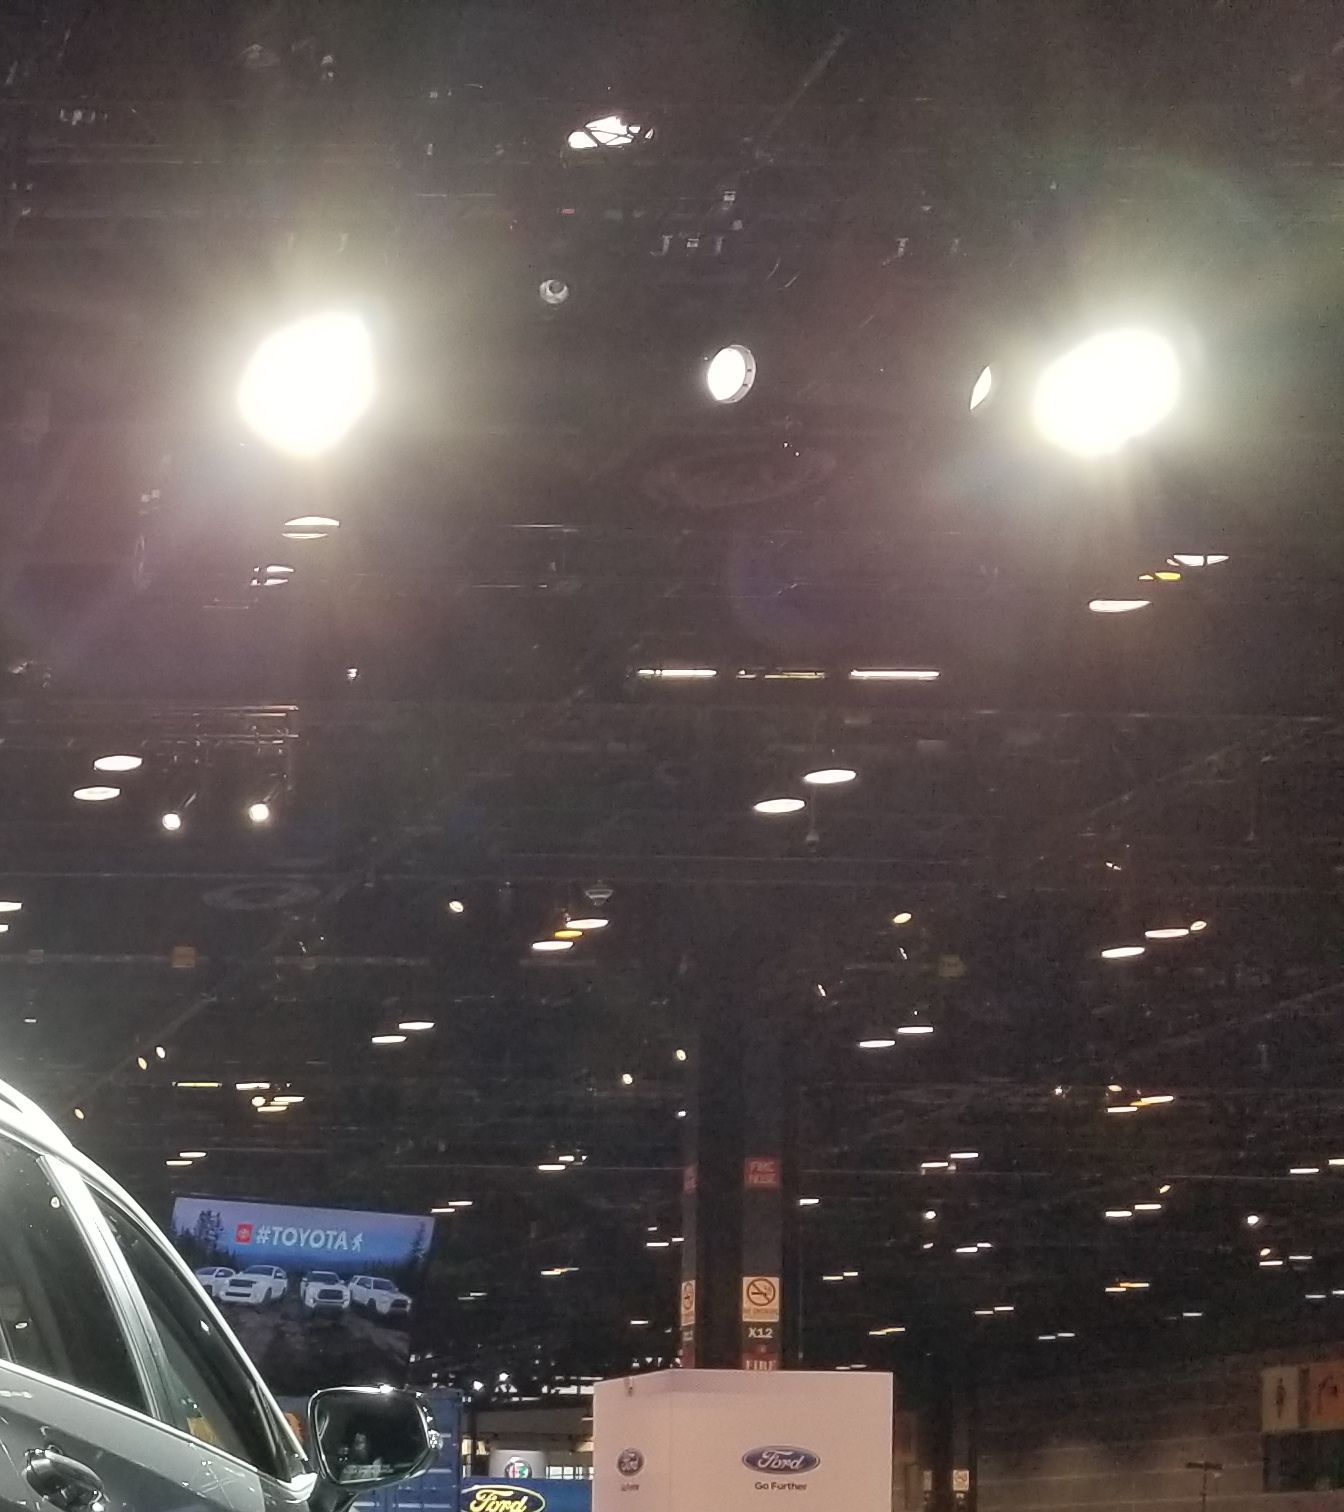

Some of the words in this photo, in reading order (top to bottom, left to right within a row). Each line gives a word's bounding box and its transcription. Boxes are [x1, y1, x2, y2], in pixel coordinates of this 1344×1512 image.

[747, 1327, 774, 1338] X12
[758, 1450, 805, 1470] Ford
[755, 1481, 769, 1491] Go
[771, 1481, 807, 1491] Further
[470, 1489, 529, 1512] Ford
